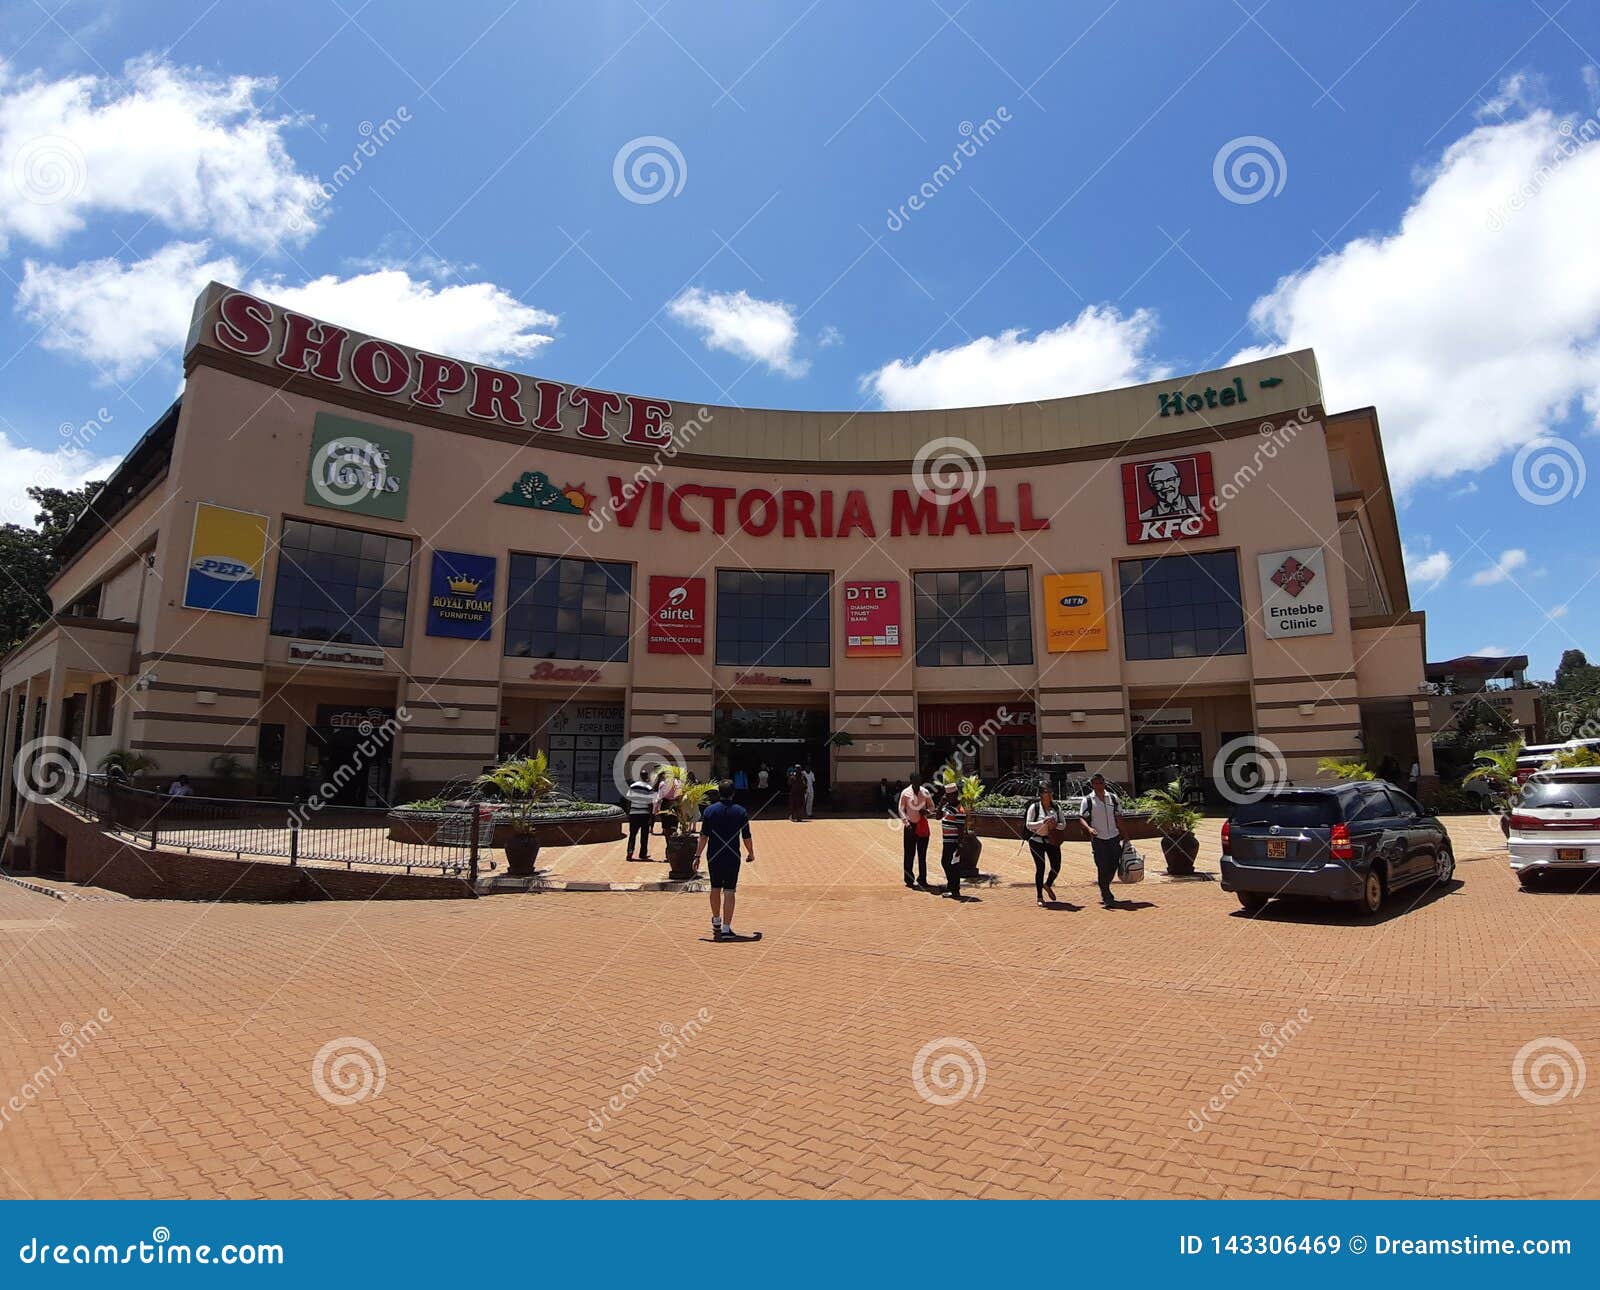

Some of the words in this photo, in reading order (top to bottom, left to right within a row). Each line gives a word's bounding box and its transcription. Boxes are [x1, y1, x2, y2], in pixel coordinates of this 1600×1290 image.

[215, 292, 675, 449] SHOPRITE
[1158, 377, 1248, 417] Hotel
[607, 475, 876, 538] VICTORIA
[890, 482, 1051, 537] MALL
[1138, 516, 1204, 541] KFC
[201, 559, 246, 576] PEP
[847, 586, 887, 599] DTB
[431, 595, 463, 609] ROYAL
[465, 599, 492, 612] FOAM
[1063, 597, 1085, 605] MTN
[440, 610, 484, 621] FURNITURE
[660, 606, 694, 620] airtel
[1270, 603, 1324, 617] Entebbe
[1280, 617, 1317, 630] Clinic
